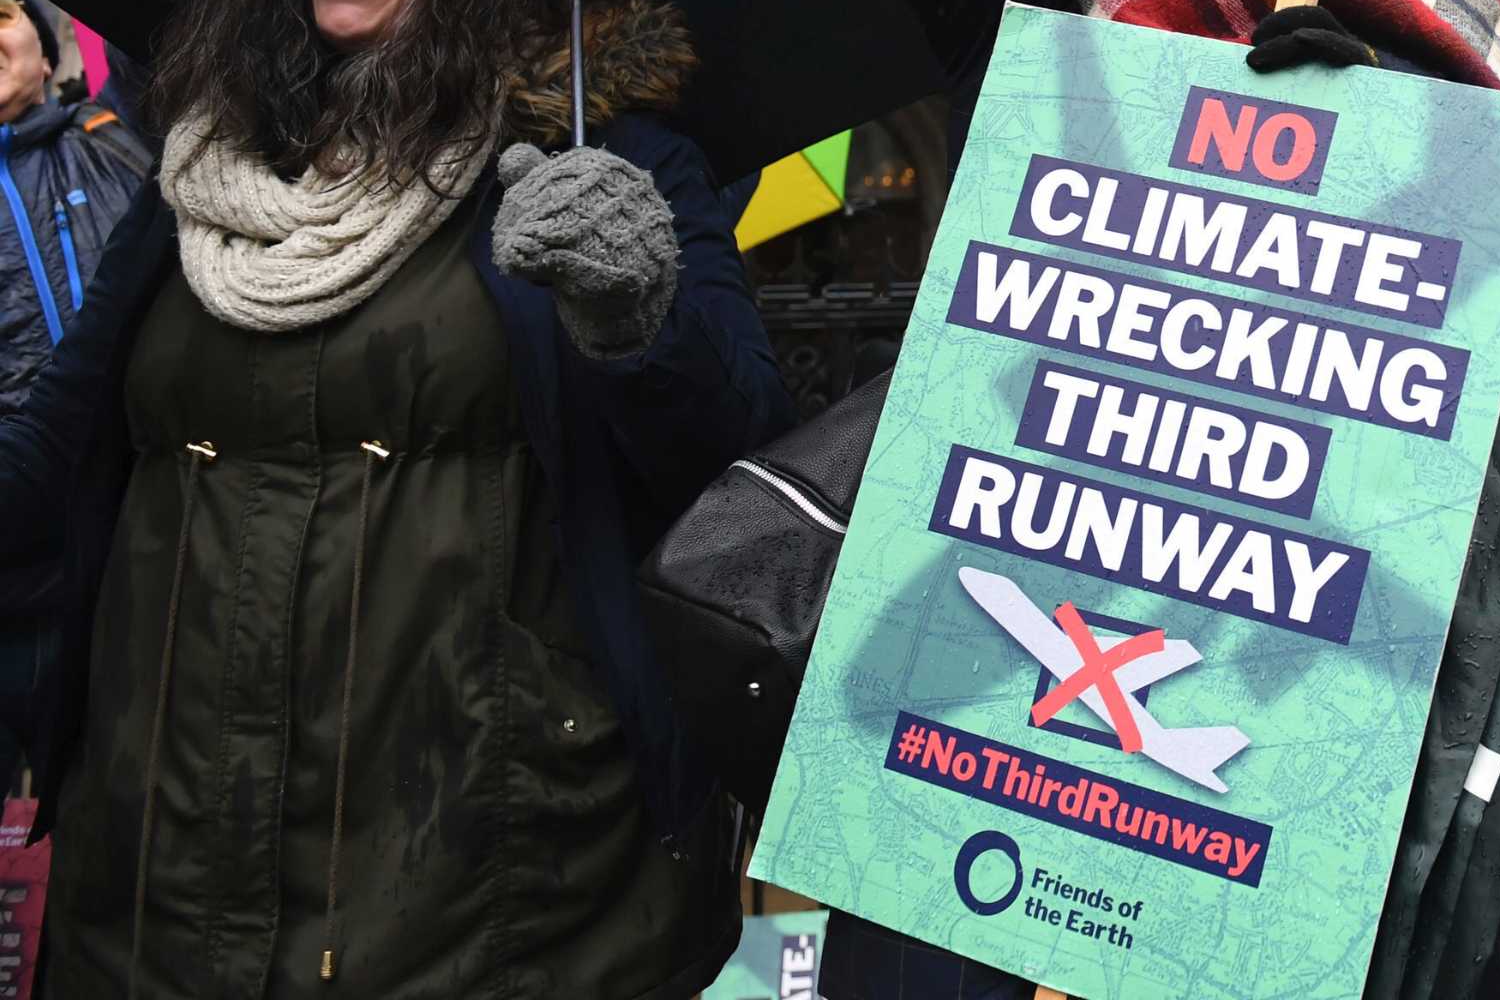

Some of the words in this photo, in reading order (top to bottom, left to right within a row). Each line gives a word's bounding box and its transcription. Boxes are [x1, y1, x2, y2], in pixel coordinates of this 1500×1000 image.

[1187, 98, 1317, 183] NO
[1029, 168, 1447, 312] CLIMATE-
[974, 251, 1448, 428] WRECKING
[1042, 370, 1311, 501] THIRD
[948, 456, 1350, 623] RUNWAY
[897, 723, 1261, 877] #NoThirdRunway
[1024, 896, 1062, 926] the
[1065, 909, 1134, 949] Earth
[1030, 866, 1114, 913] Friends
[1118, 900, 1144, 921] of
